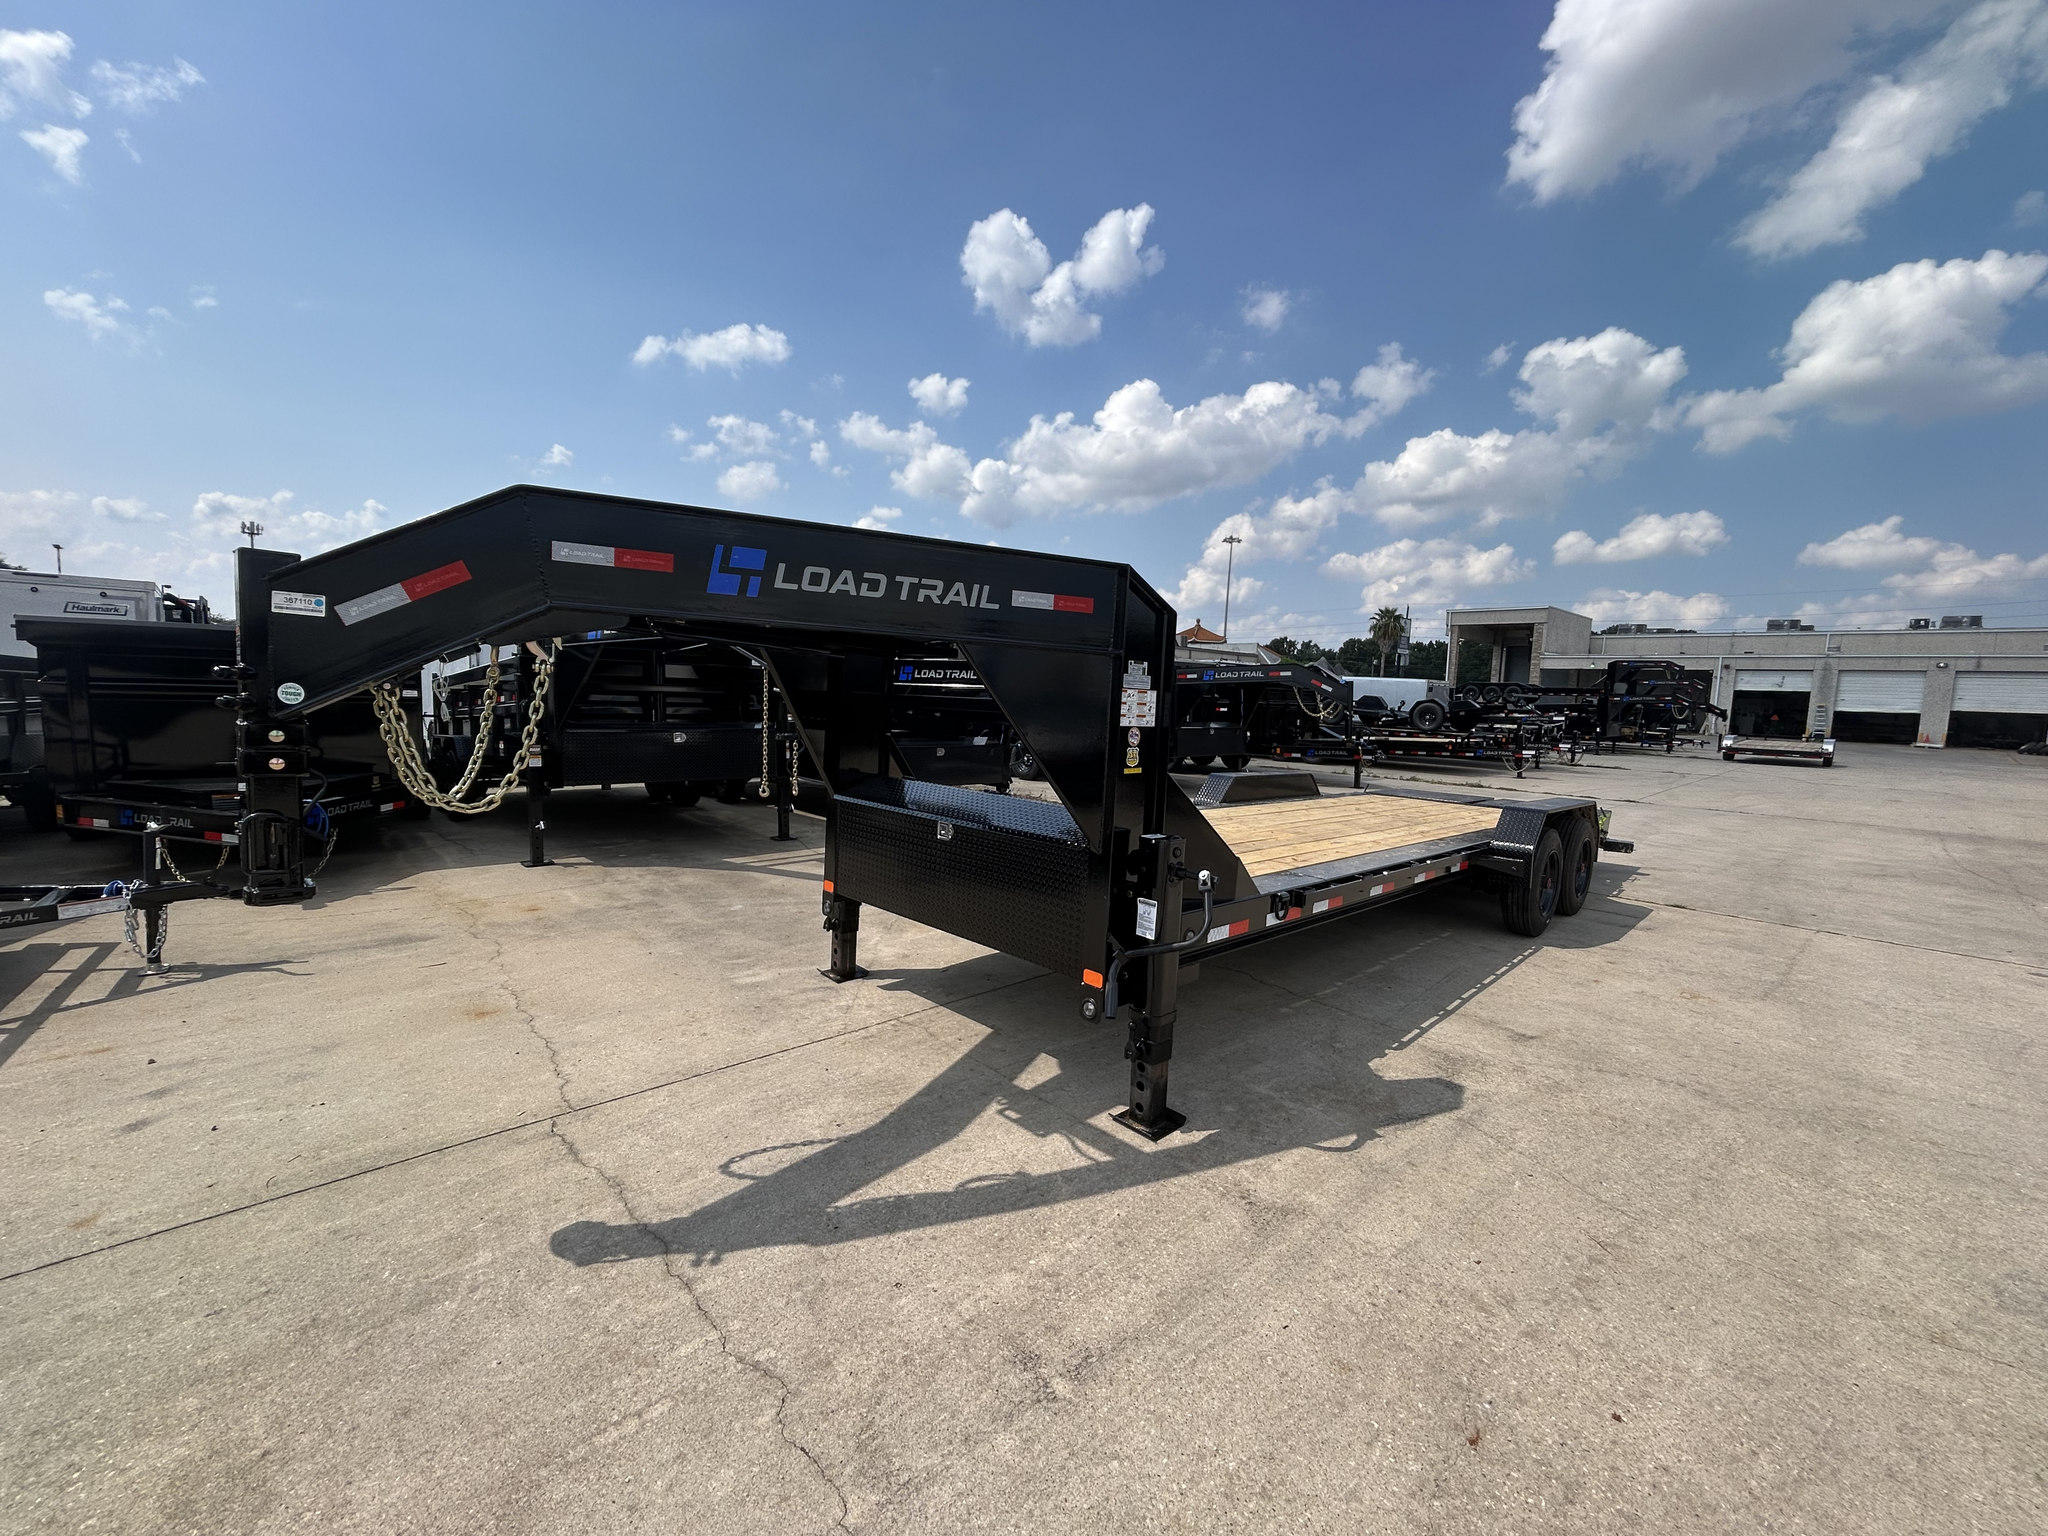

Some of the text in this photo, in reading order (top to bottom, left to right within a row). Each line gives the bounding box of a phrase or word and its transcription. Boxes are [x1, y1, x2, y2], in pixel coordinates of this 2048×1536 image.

[774, 562, 1000, 610] LOAD TRAIL
[72, 604, 120, 613] Haulmark
[914, 669, 977, 679] LOAD TRAIL
[1215, 670, 1264, 679] LOAD TRAIL
[326, 799, 374, 817] OAD TRAIL
[167, 816, 194, 829] RAIL
